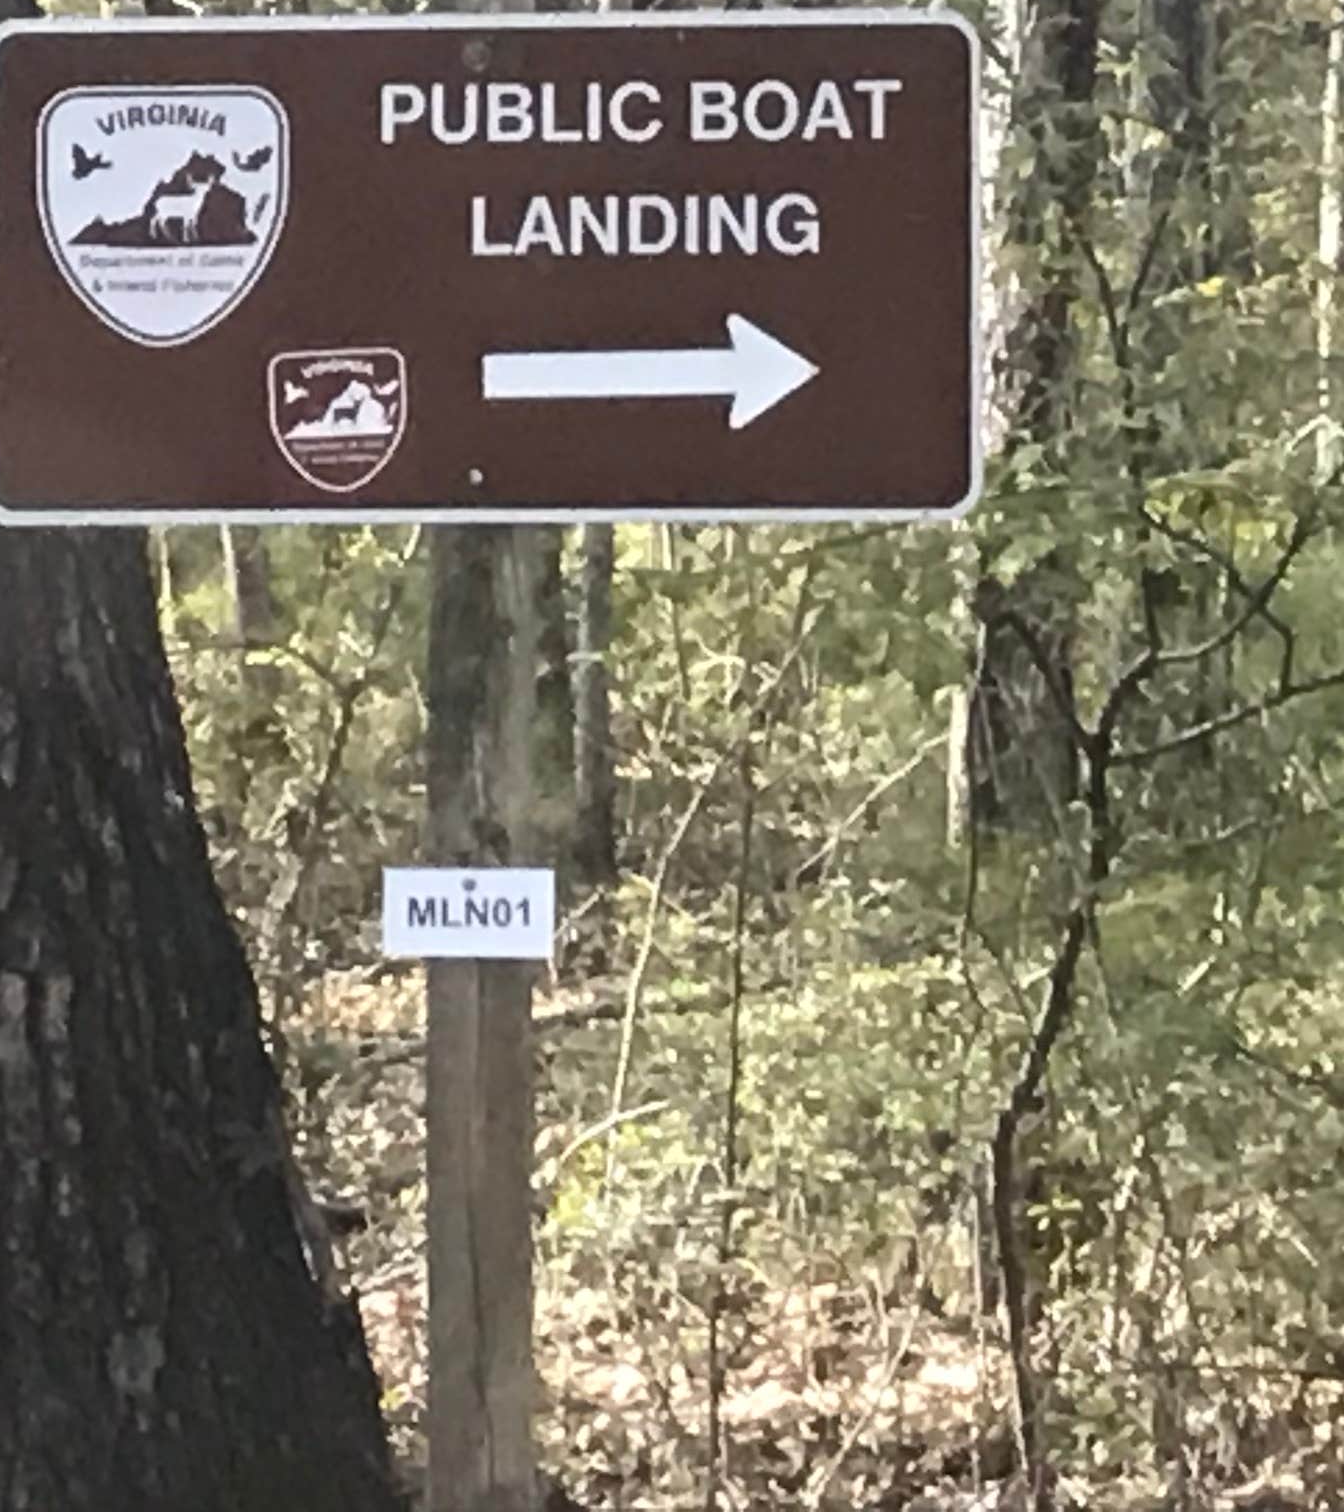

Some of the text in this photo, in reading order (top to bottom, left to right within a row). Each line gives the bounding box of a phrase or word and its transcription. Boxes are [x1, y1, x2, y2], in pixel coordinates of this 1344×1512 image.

[95, 103, 227, 137] VIRGINIA
[380, 79, 903, 144] PUBLIC BOAT
[471, 193, 821, 256] LANDING
[408, 897, 531, 927] MLN01
